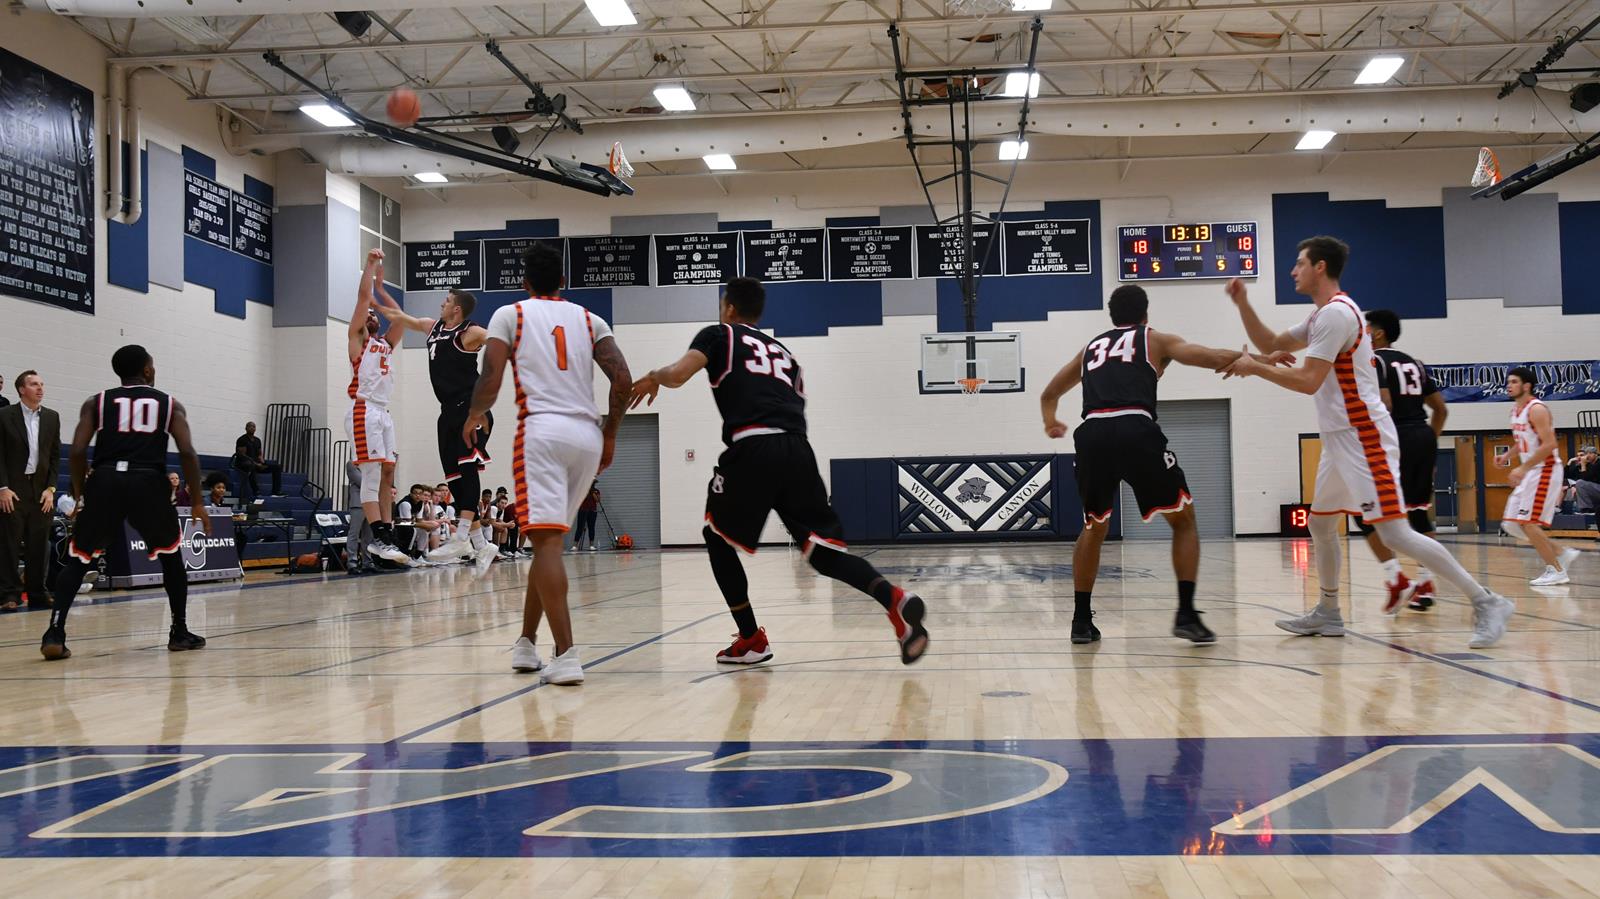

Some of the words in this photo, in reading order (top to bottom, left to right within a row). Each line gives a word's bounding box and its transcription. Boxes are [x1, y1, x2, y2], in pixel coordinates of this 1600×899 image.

[41, 203, 56, 217] MAKE
[22, 212, 45, 228] DISPLAY
[1124, 228, 1146, 236] HOME
[1226, 224, 1252, 232] GUEST
[4, 222, 17, 234] AND
[19, 226, 39, 241] SILVER
[55, 237, 65, 248] ALL
[67, 240, 74, 251] TO
[1238, 237, 1252, 250] 18
[30, 244, 56, 260] WILDCATS
[1134, 240, 1148, 254] 18
[1196, 244, 1200, 253] 1
[10, 254, 34, 269] CANYON
[36, 261, 53, 274] BRING
[65, 268, 87, 283] VICTORY
[1133, 264, 1137, 272] 1
[1152, 262, 1160, 272] 5
[1218, 260, 1225, 270] 5
[1246, 259, 1252, 269] 0
[584, 273, 636, 281] CHAMPIONS
[674, 270, 721, 279] CHAMPIONS
[552, 326, 568, 370] 1
[1087, 330, 1136, 371] 34
[380, 356, 389, 375] 5
[742, 334, 792, 386] 32
[1391, 362, 1422, 395] 13
[1432, 366, 1508, 387] WILLOW
[1518, 364, 1592, 384] ANYON
[1553, 383, 1575, 393] the
[114, 397, 159, 432] 10
[911, 482, 953, 521] WILLOW
[998, 480, 1040, 520] CANYON
[1292, 510, 1306, 526] 13
[193, 538, 235, 547] WILDCATS
